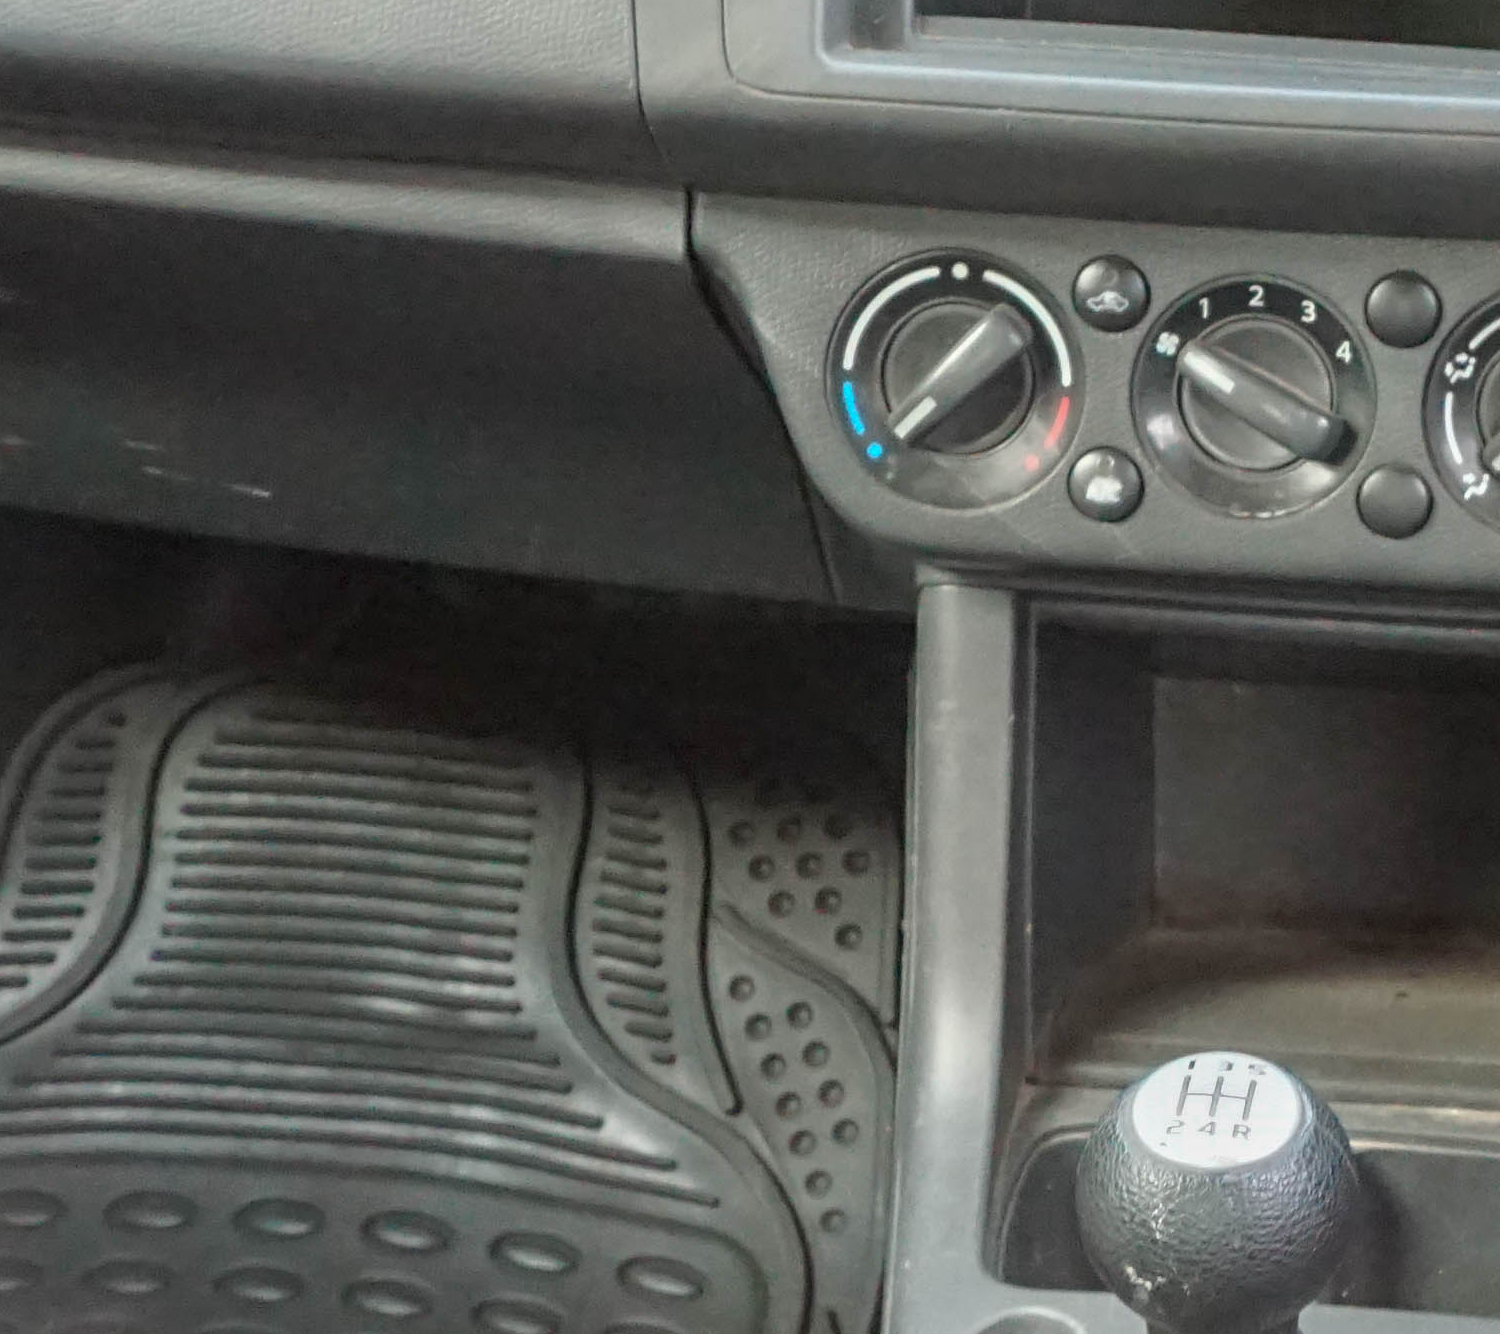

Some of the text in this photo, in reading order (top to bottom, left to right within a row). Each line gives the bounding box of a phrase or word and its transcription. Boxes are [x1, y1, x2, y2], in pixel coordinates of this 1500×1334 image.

[1248, 284, 1265, 307] 2
[1199, 296, 1211, 319] 1
[1300, 299, 1318, 324] 3
[1334, 340, 1352, 364] 4
[1166, 1119, 1251, 1139] 2 4 R
